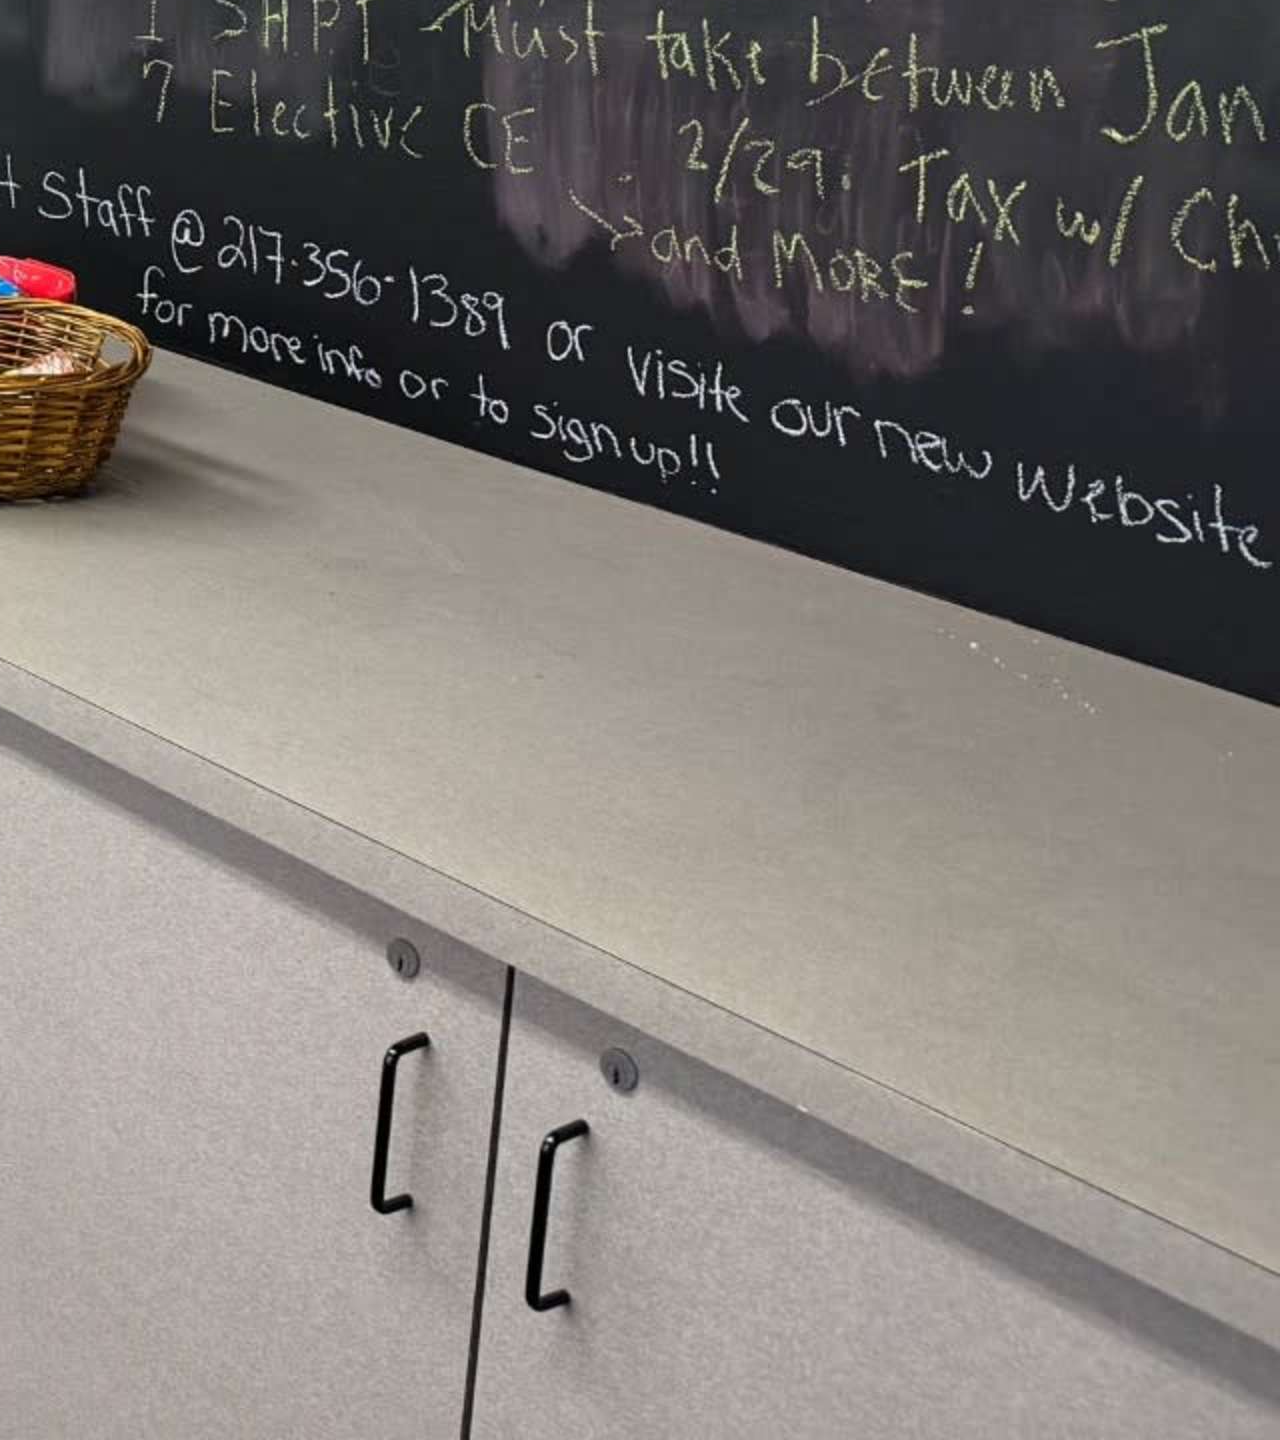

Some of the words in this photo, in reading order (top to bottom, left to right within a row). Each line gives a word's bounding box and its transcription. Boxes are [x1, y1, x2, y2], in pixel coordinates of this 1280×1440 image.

[463, 0, 606, 77] Must
[645, 8, 767, 92] take
[804, 14, 1068, 115] between
[142, 59, 174, 123] 7
[209, 66, 424, 159] Elective
[464, 102, 536, 174] CE
[650, 223, 744, 281] and
[1056, 173, 1144, 268] w/
[1171, 186, 1280, 273] Ch
[38, 167, 156, 239] Staff
[546, 319, 594, 363] or
[770, 397, 863, 448] our
[873, 418, 994, 481] new
[136, 265, 194, 328] for
[398, 369, 450, 401] or
[468, 372, 510, 426] to
